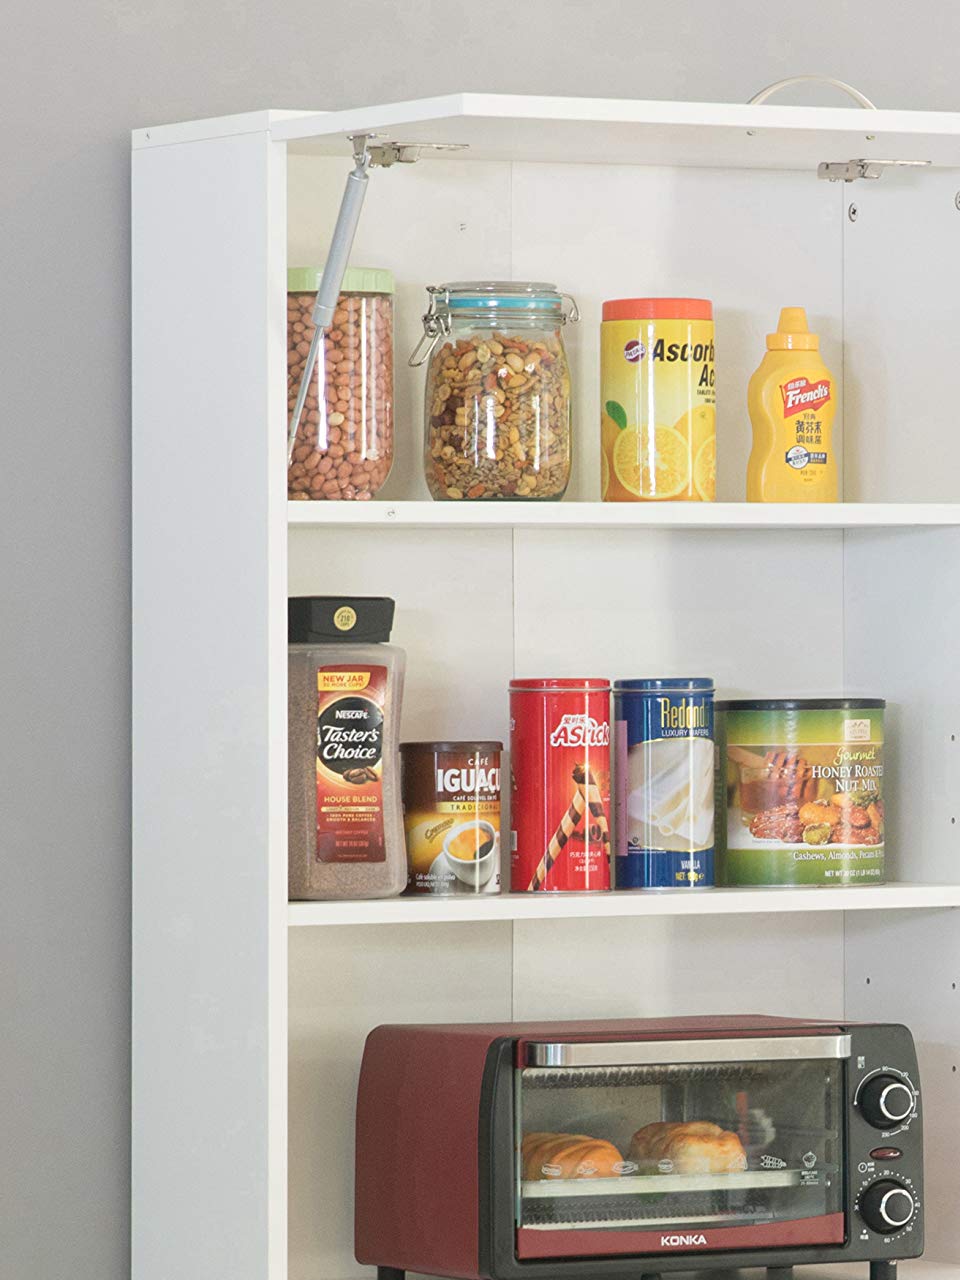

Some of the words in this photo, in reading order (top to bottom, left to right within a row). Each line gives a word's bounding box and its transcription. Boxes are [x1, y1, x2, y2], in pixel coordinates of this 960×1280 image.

[786, 384, 828, 408] French's
[322, 725, 380, 742] Taster's
[322, 743, 377, 760] Choice
[833, 746, 876, 766] Gourmet
[811, 766, 853, 778] HONEY
[835, 779, 860, 792] NUT
[324, 795, 351, 803] HOUSE
[352, 795, 378, 803] BLEND
[661, 1234, 707, 1247] KONKA
